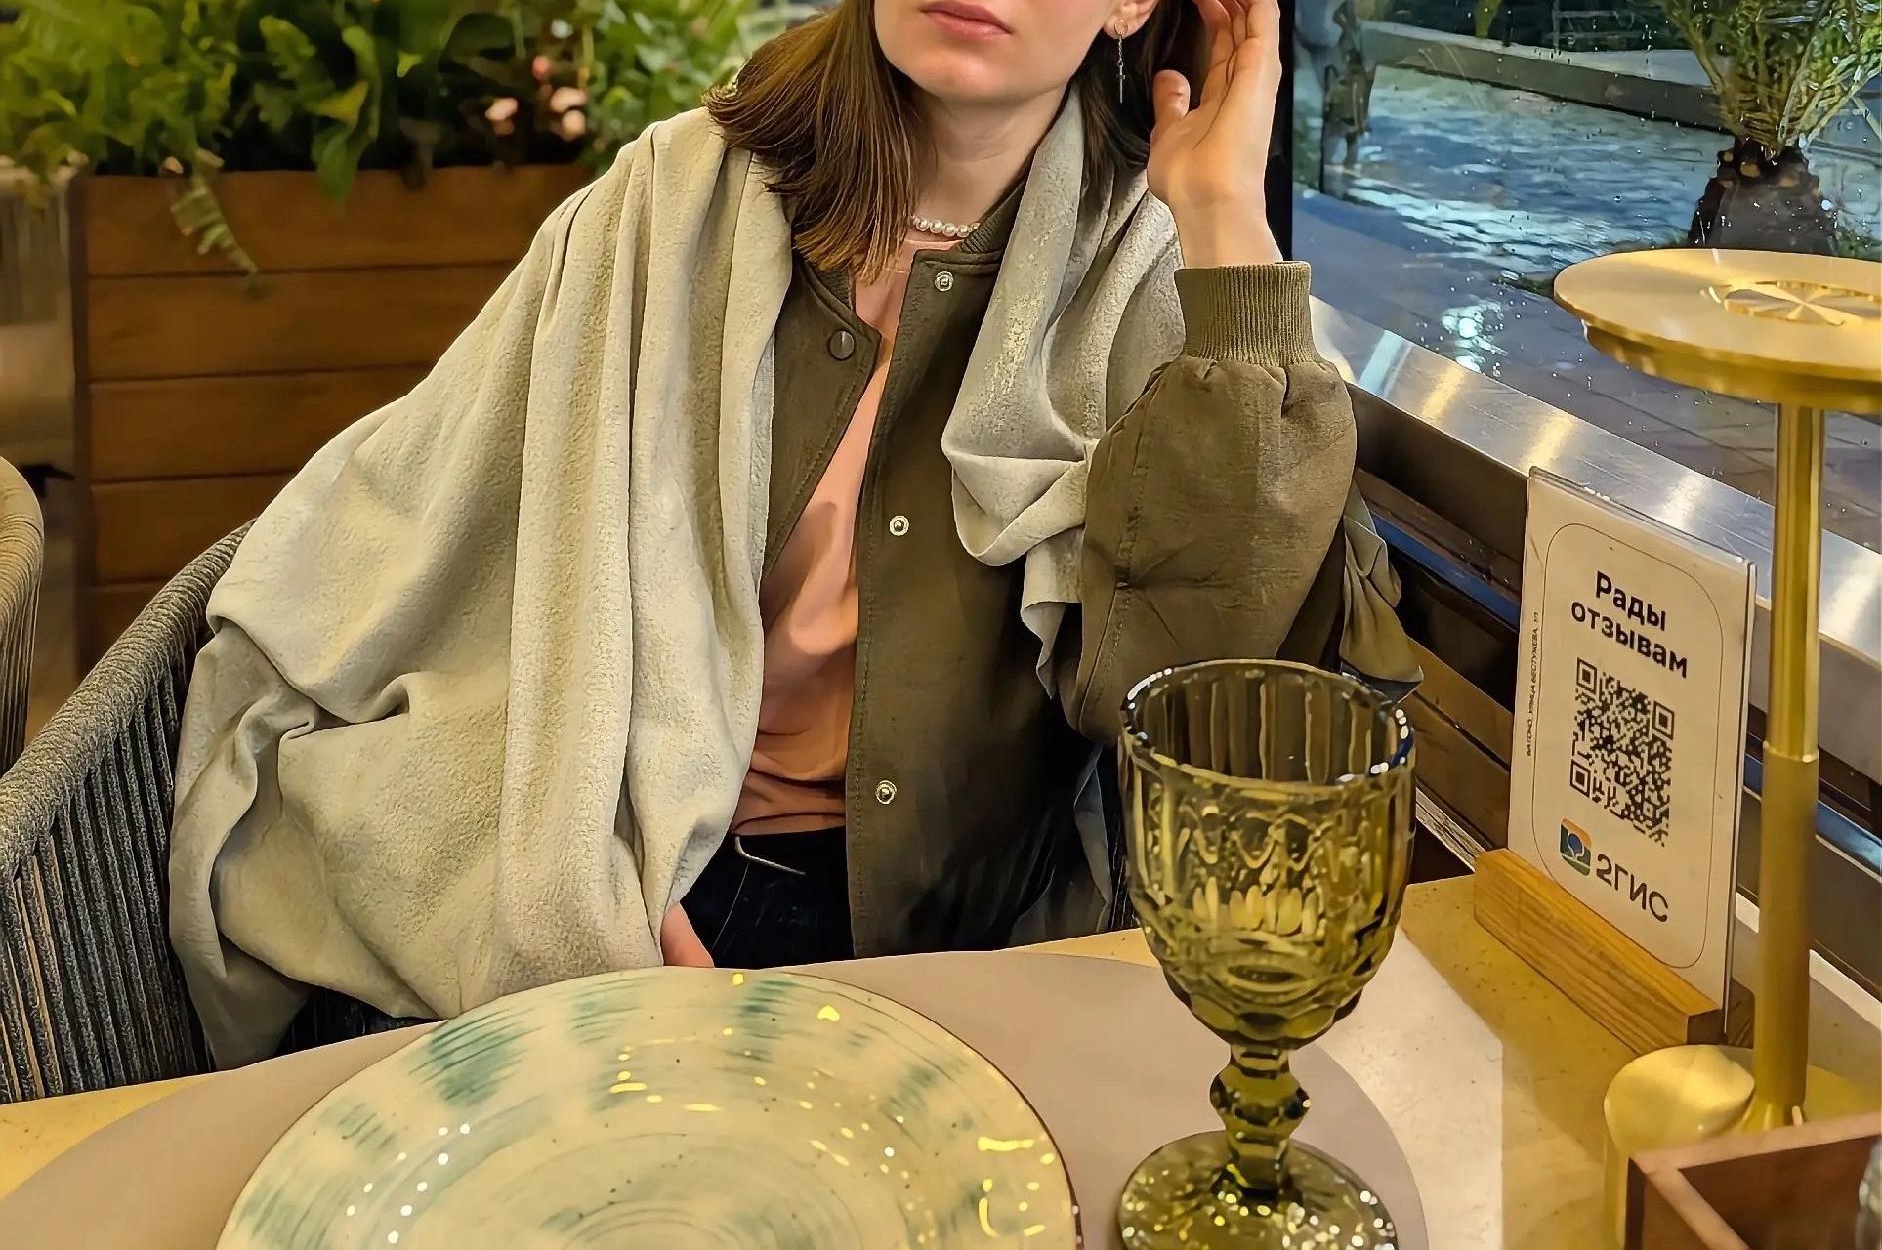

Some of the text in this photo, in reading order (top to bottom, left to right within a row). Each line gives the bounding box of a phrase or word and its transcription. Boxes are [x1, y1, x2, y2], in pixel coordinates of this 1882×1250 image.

[1595, 570, 1666, 632] Рады
[1570, 601, 1688, 679] отзывам
[1596, 853, 1669, 923] 2ГИС
